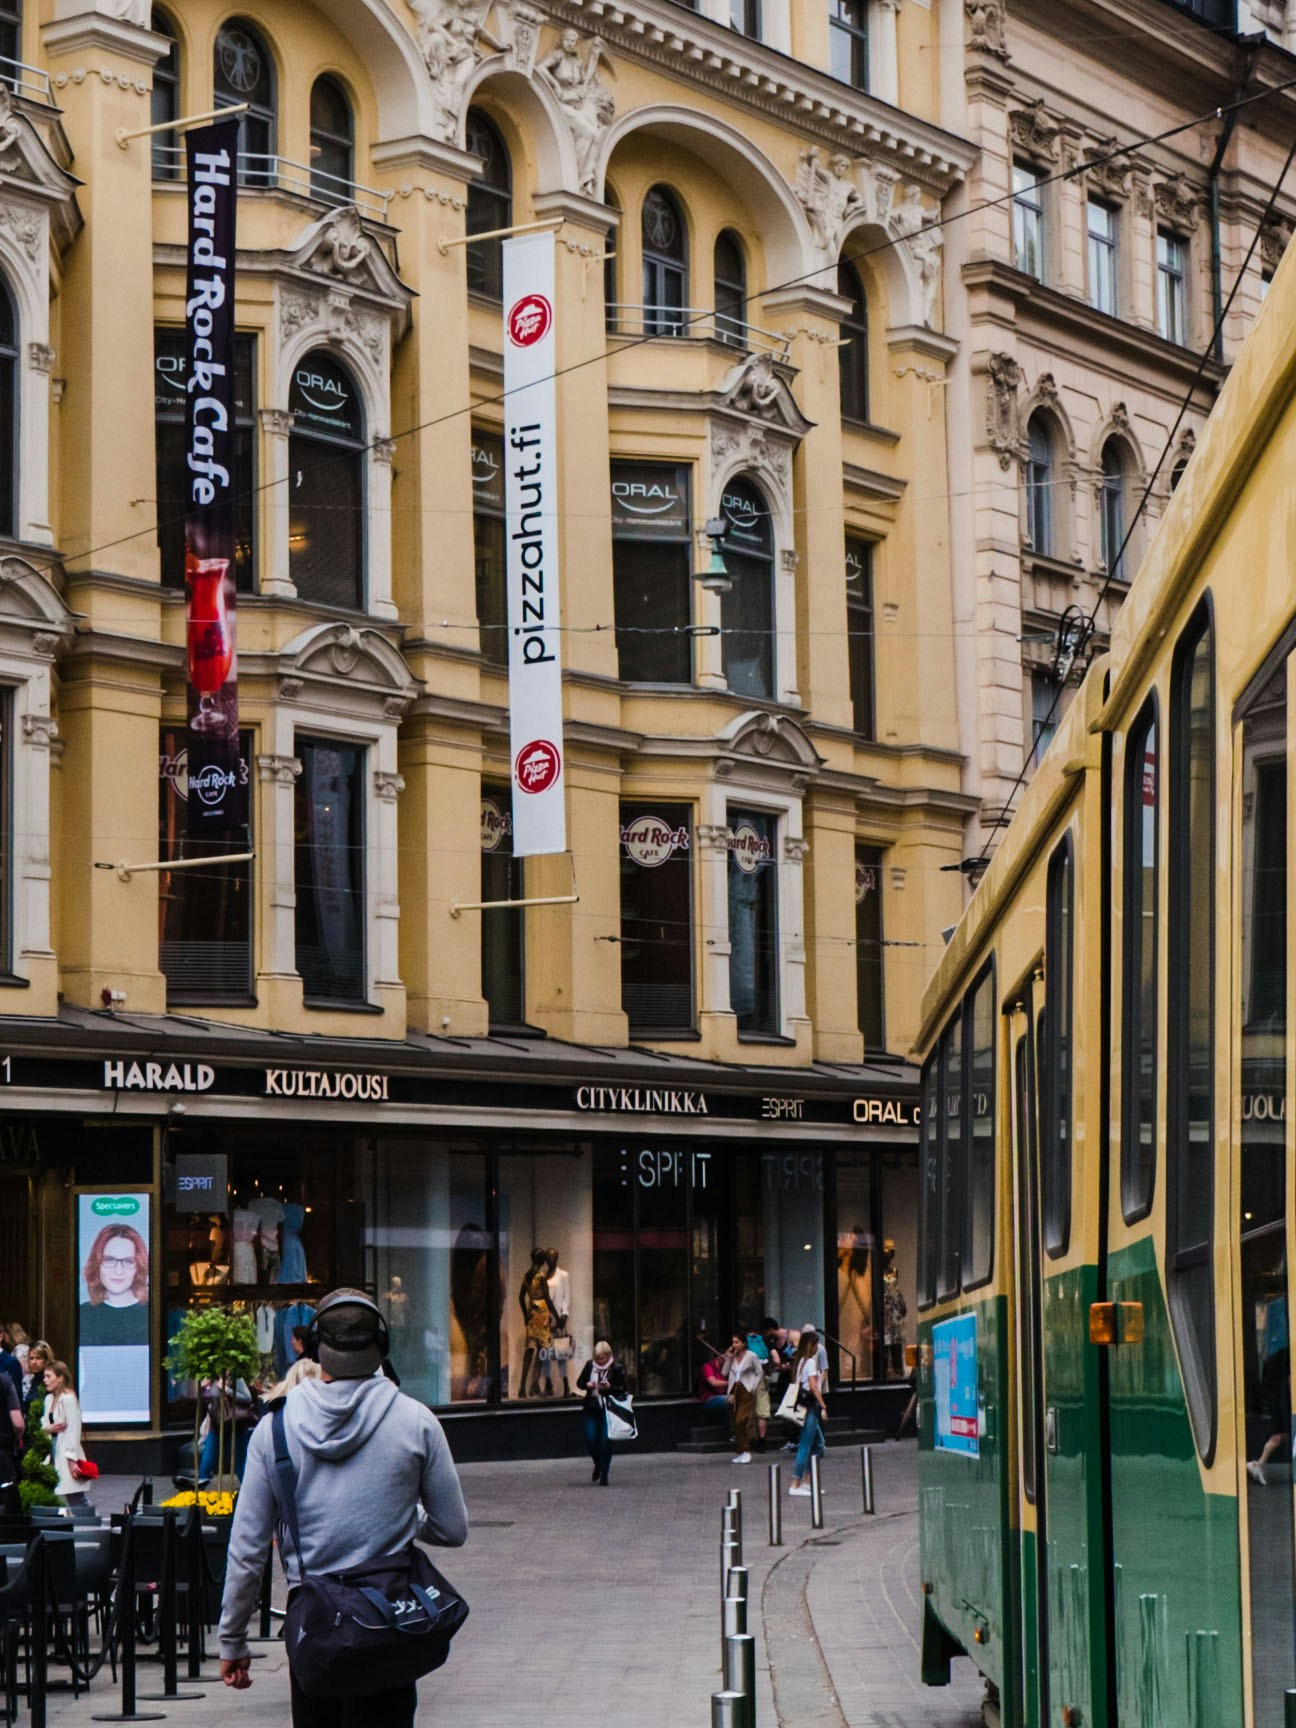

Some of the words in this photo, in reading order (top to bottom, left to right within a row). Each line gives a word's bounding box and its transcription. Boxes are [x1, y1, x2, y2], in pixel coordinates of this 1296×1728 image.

[193, 148, 231, 270] Hard
[186, 274, 226, 394] Rock
[515, 314, 543, 334] Pizza
[519, 322, 540, 341] Hut
[296, 370, 349, 398] ORAL
[186, 396, 230, 506] Cafe
[612, 482, 678, 499] ORAL
[722, 493, 760, 516] ORAL
[511, 424, 555, 665] pizzahut.fi
[188, 774, 212, 791] Hard
[211, 770, 236, 790] Rock
[523, 761, 550, 779] Pizza
[527, 769, 549, 787] Hut
[487, 811, 512, 835] Rock
[650, 827, 689, 849] Rock
[747, 835, 770, 858] Rock
[104, 1061, 215, 1091] HARALD
[265, 1069, 390, 1101] KULTAJOUSI
[576, 1085, 709, 1114] CITYKLINIKKA
[761, 1097, 805, 1120] ESPRIT
[853, 1098, 909, 1124] ORAL
[178, 1176, 215, 1191] ESPRIT
[95, 1201, 137, 1213] Specsavers
